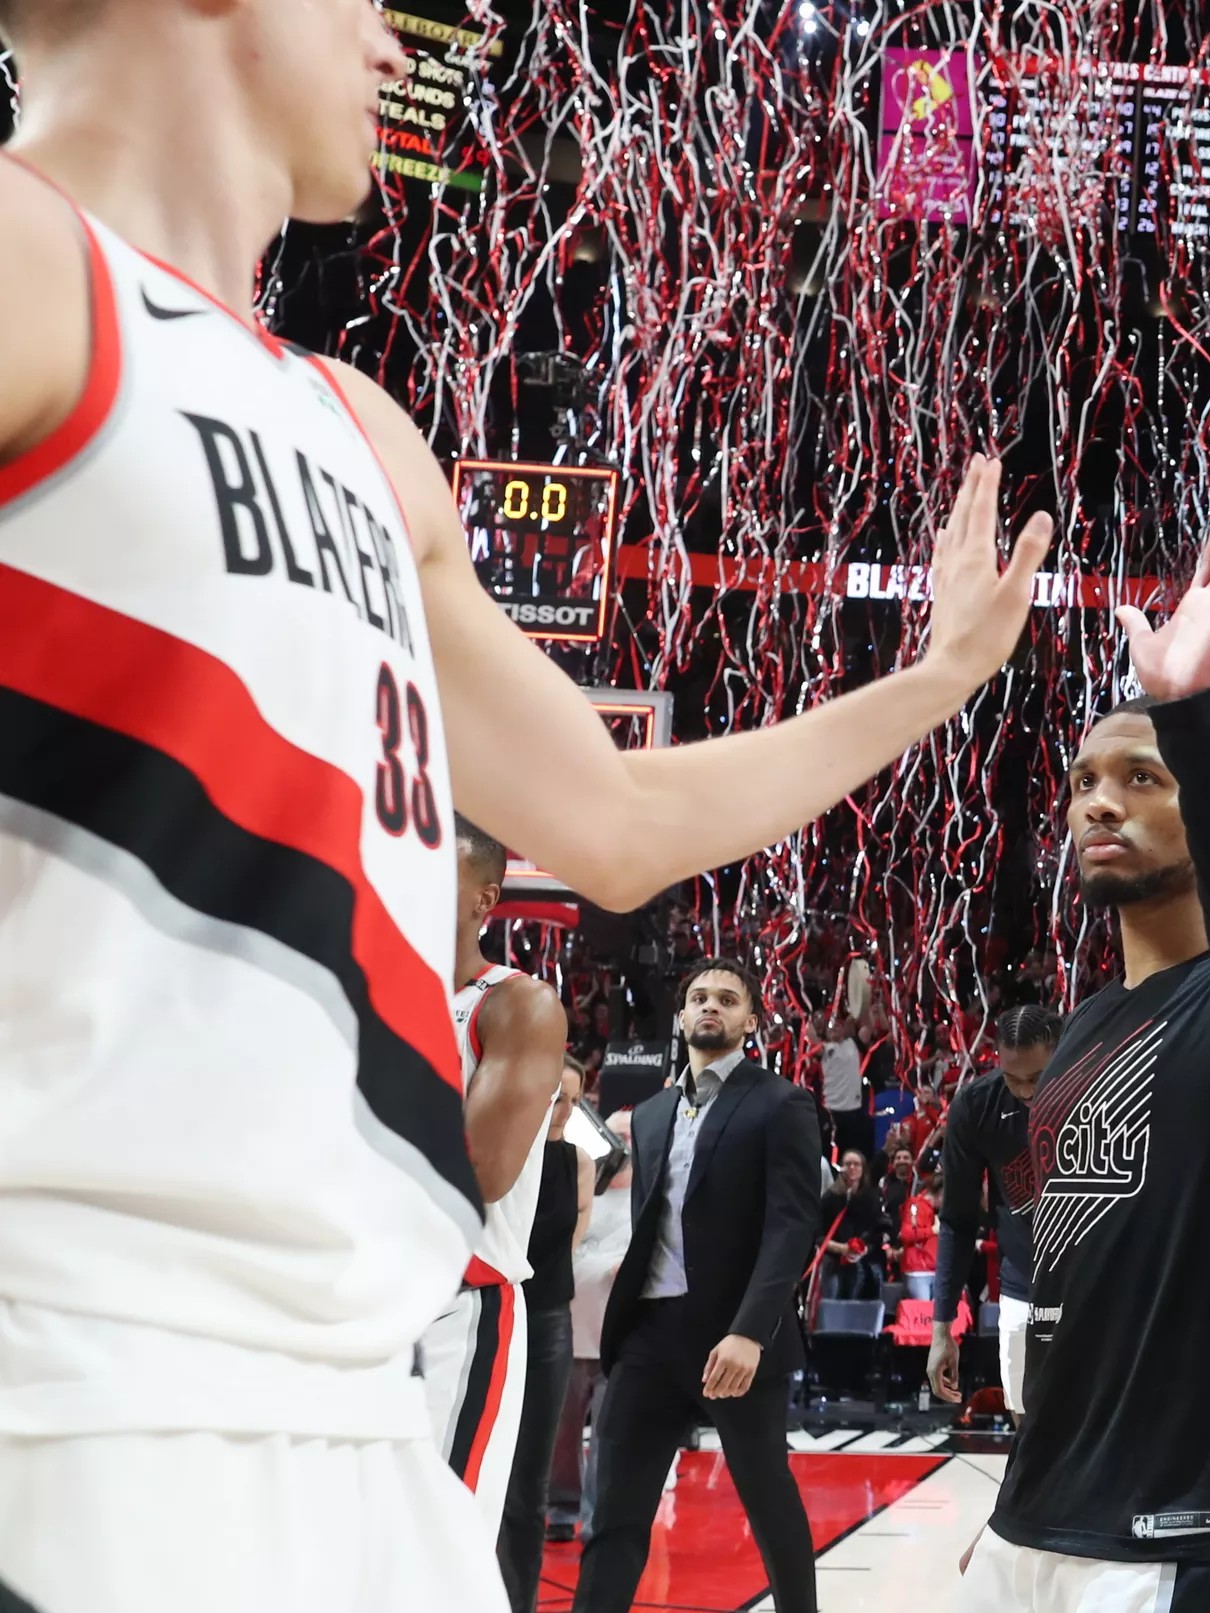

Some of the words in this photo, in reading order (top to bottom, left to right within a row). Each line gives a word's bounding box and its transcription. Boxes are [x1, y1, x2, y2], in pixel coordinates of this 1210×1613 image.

[379, 99, 446, 130] TEALS
[1171, 106, 1210, 122] PONTS
[503, 480, 568, 522] 0.0
[175, 408, 415, 661] BLAZERS
[847, 562, 934, 602] BLAZ
[1031, 572, 1075, 608] IN
[375, 660, 442, 851] 33
[605, 1053, 663, 1067] SPALDING
